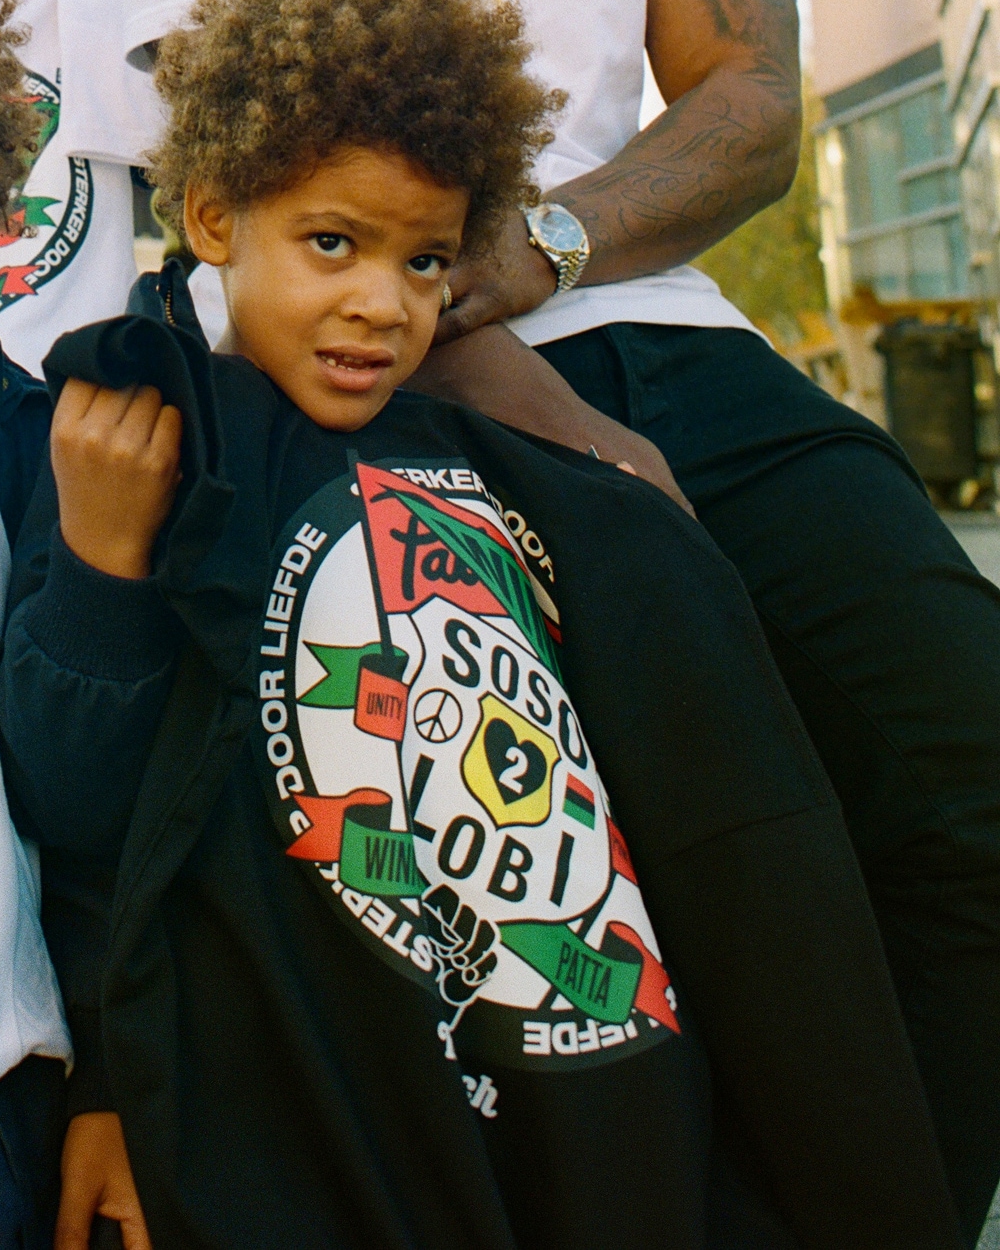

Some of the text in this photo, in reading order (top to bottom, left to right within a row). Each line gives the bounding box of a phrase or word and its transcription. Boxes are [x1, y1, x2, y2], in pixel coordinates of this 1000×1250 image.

[260, 522, 328, 656] LIEFDE
[442, 618, 588, 770] SOSO
[409, 753, 575, 908] LOBI
[499, 745, 529, 796] 2
[555, 940, 613, 1009] PATTA
